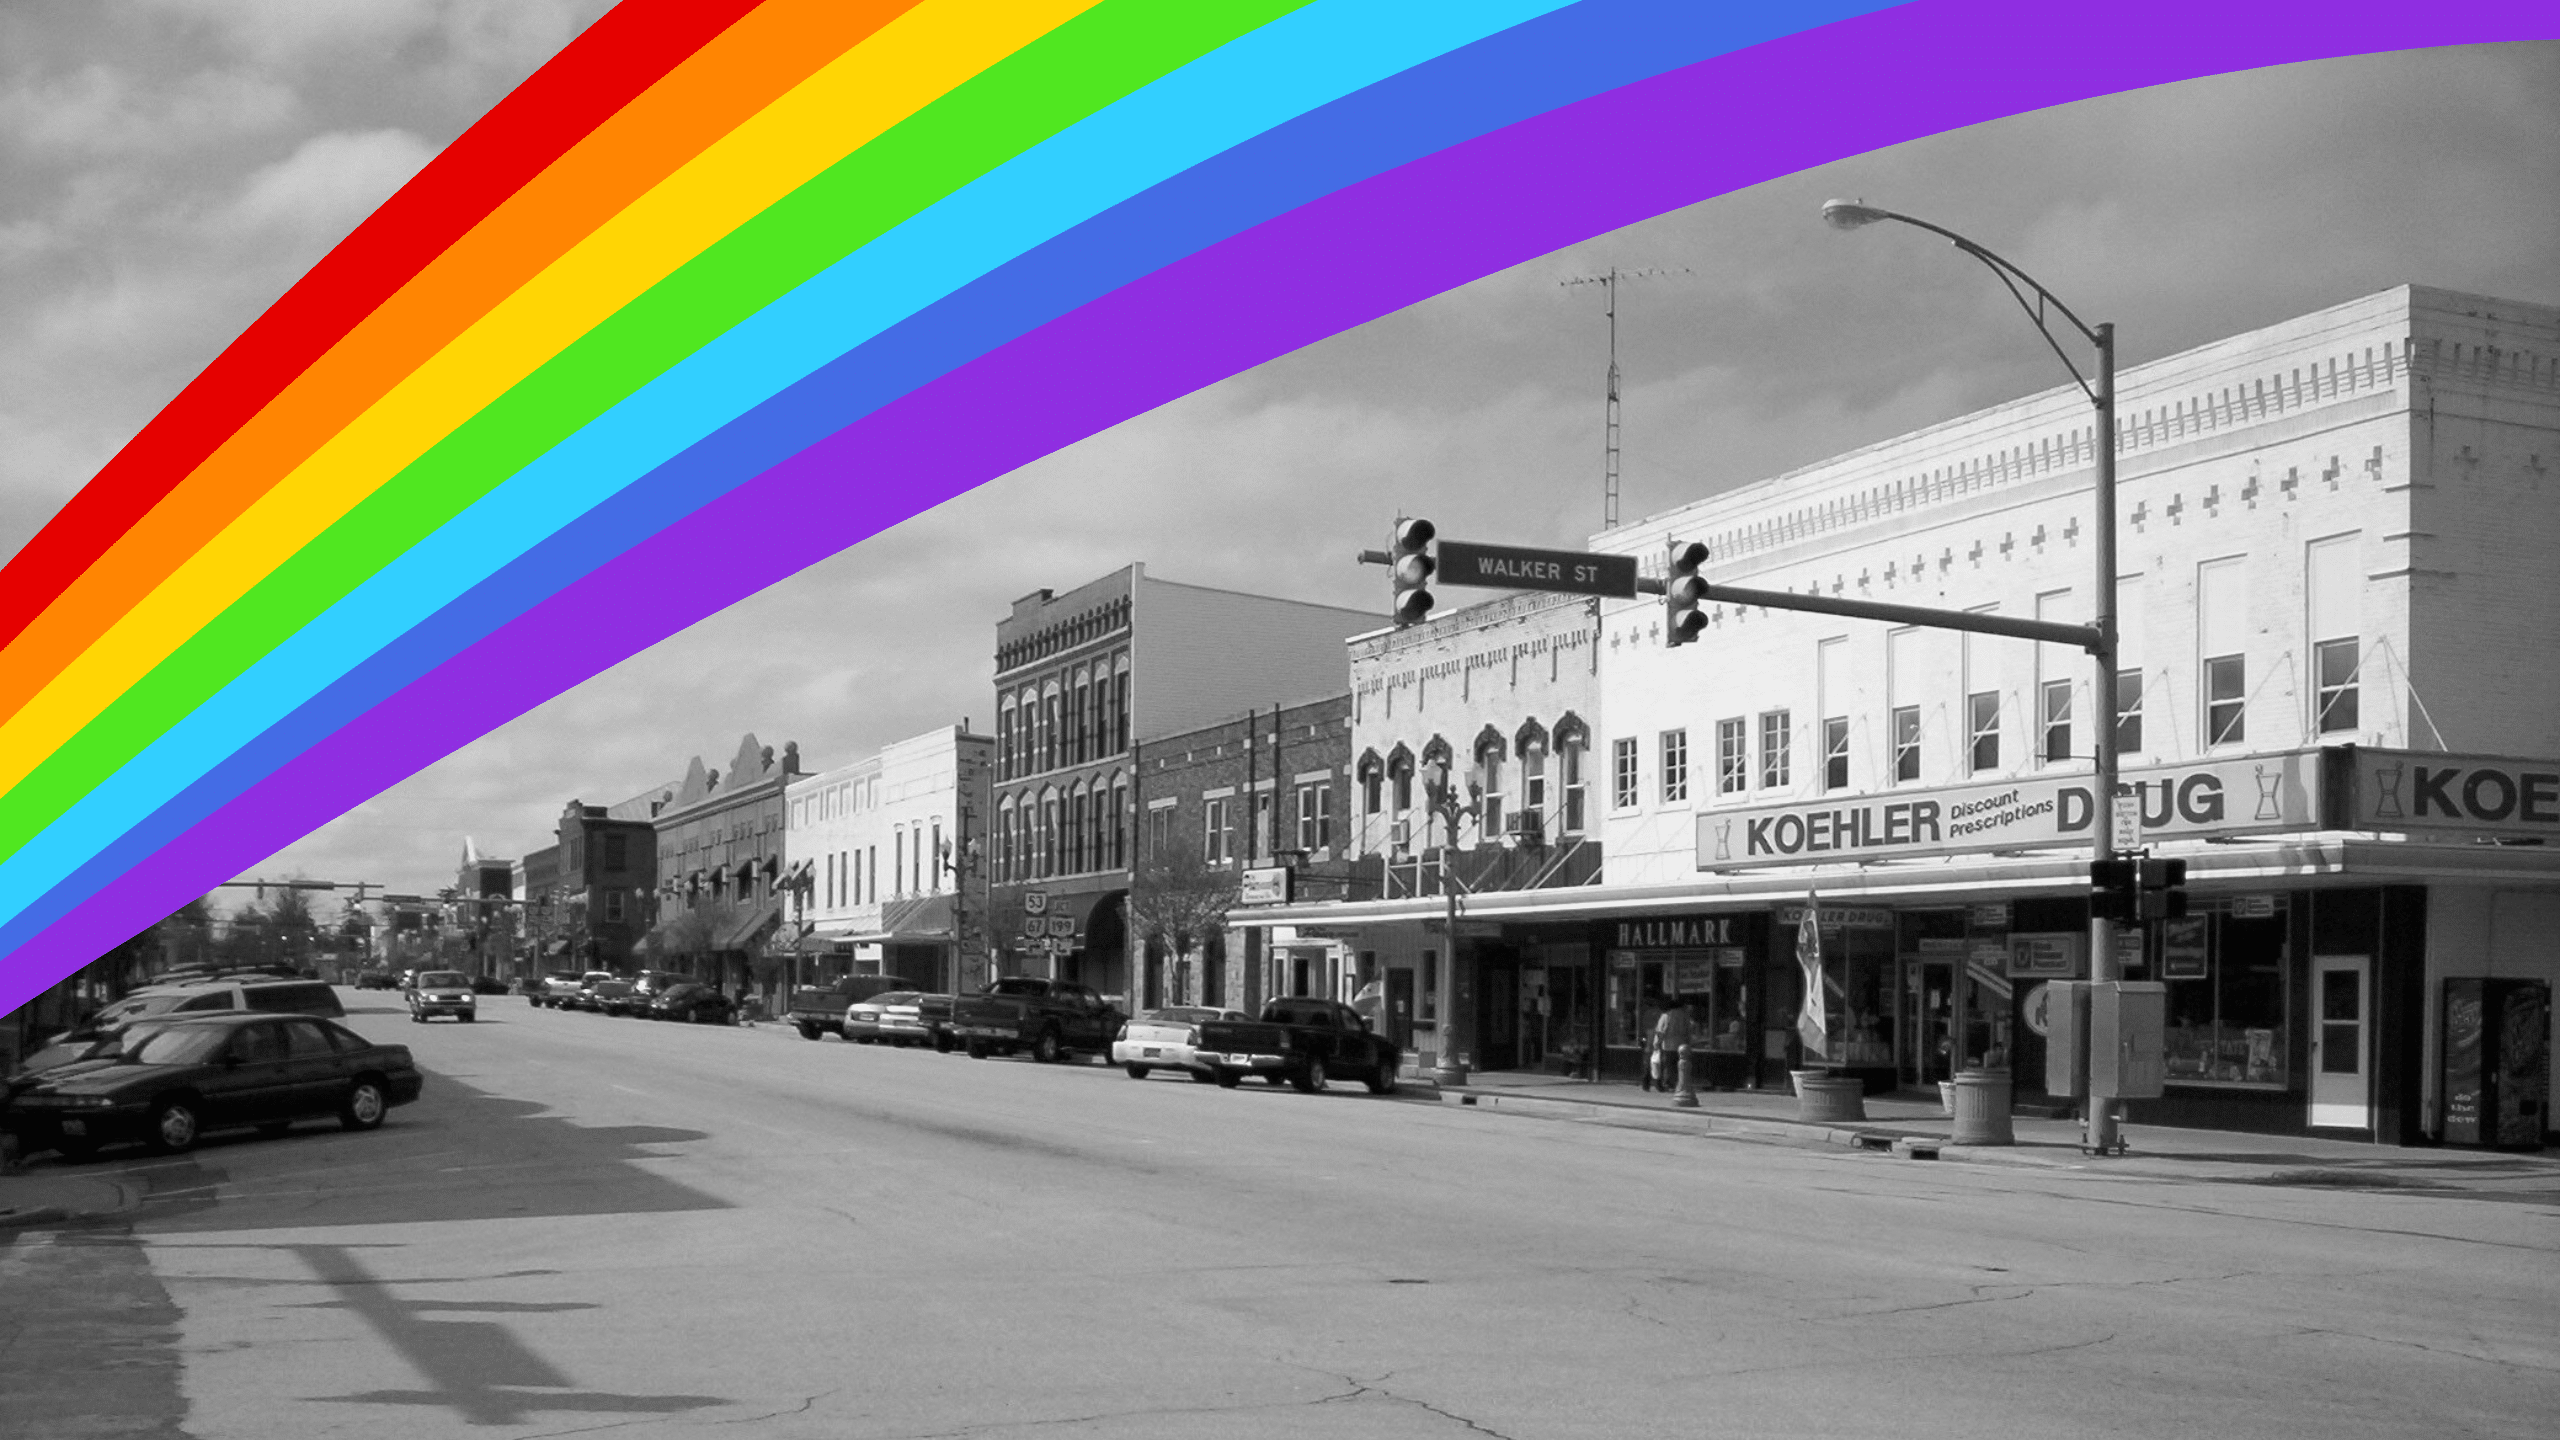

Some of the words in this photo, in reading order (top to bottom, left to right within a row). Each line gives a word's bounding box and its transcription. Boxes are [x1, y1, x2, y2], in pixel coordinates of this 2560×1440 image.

[1478, 557, 1561, 580] WALKER
[1574, 565, 1598, 582] ST
[1951, 788, 2019, 820] Discount
[2057, 773, 2224, 833] DUG
[2414, 766, 2560, 822] KOE
[1748, 800, 1941, 856] KOEHLER
[1950, 800, 2054, 838] Prescriptions
[1028, 895, 1043, 909] 53
[1783, 909, 1846, 922] KOLER
[1027, 920, 1041, 932] 67
[1051, 920, 1072, 932] 199
[1619, 919, 1731, 947] HALLMARK
